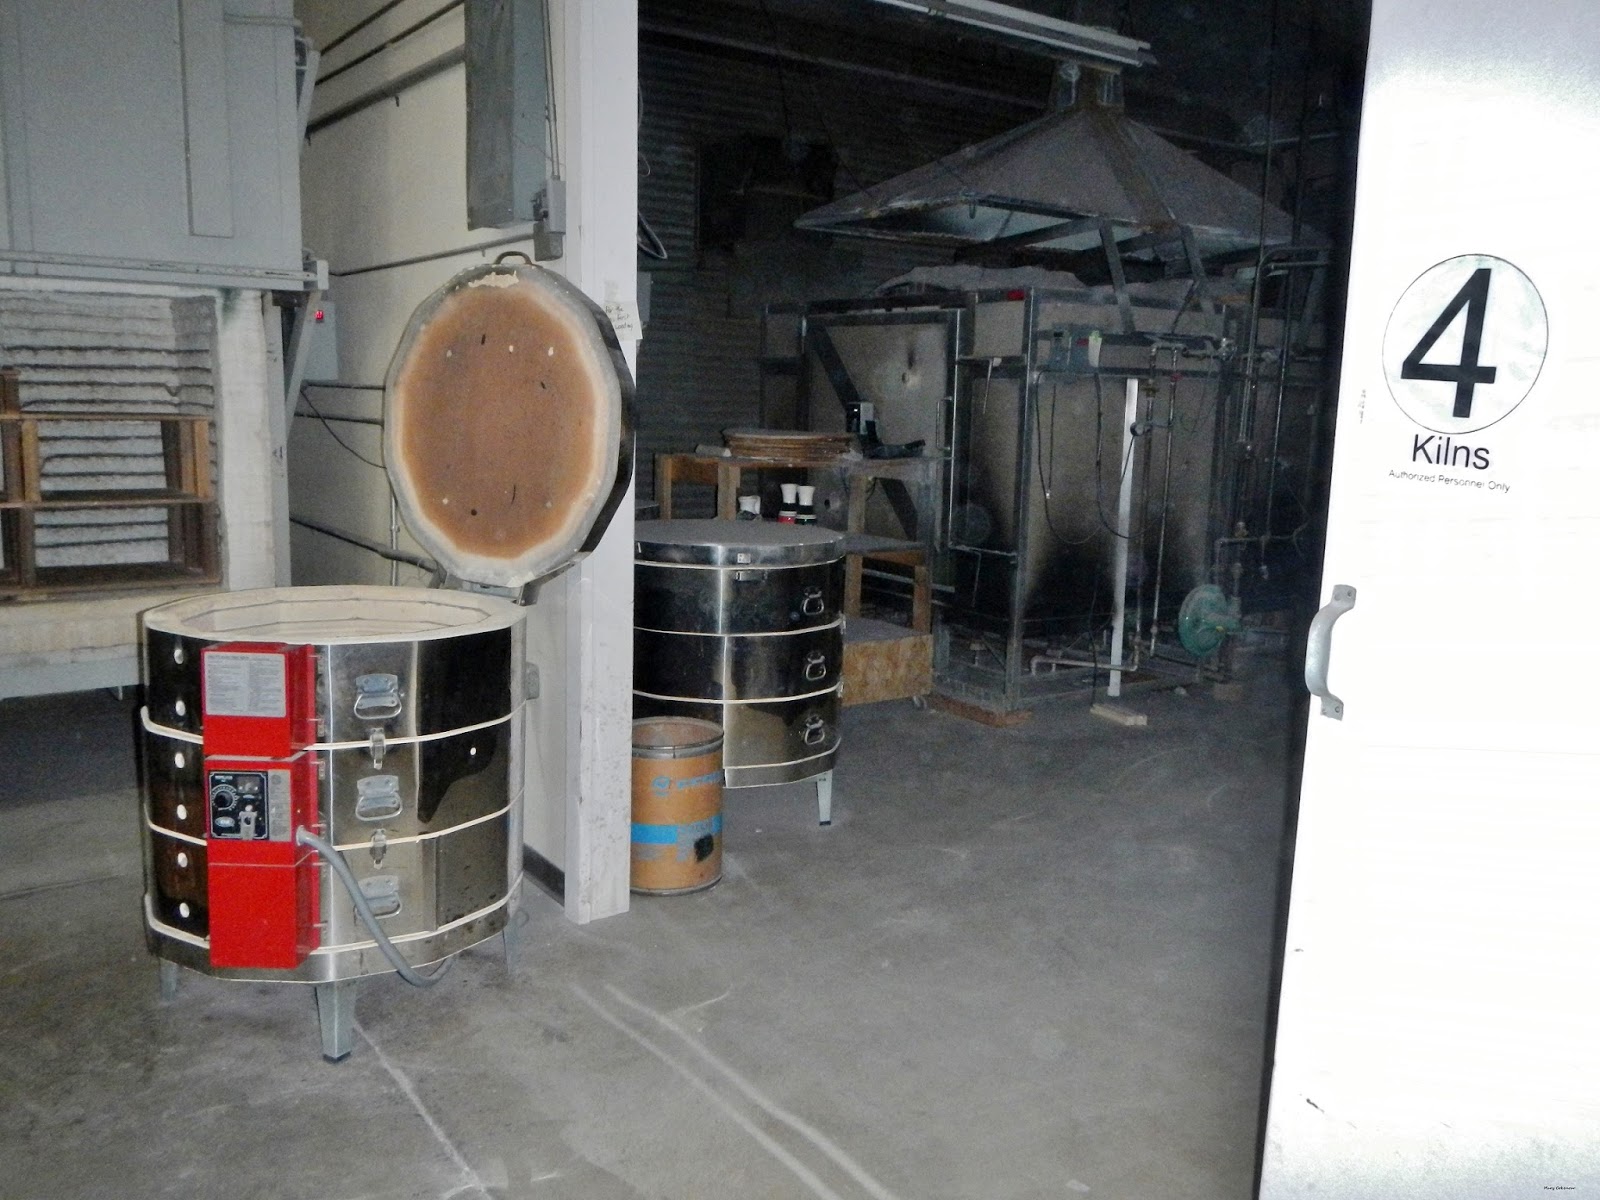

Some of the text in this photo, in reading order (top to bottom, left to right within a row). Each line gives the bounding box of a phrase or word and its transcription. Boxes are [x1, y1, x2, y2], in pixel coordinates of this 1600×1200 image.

[1400, 268, 1497, 419] 4
[1412, 433, 1490, 470] Kilns
[1388, 469, 1511, 494] Authorized Personnel Only
